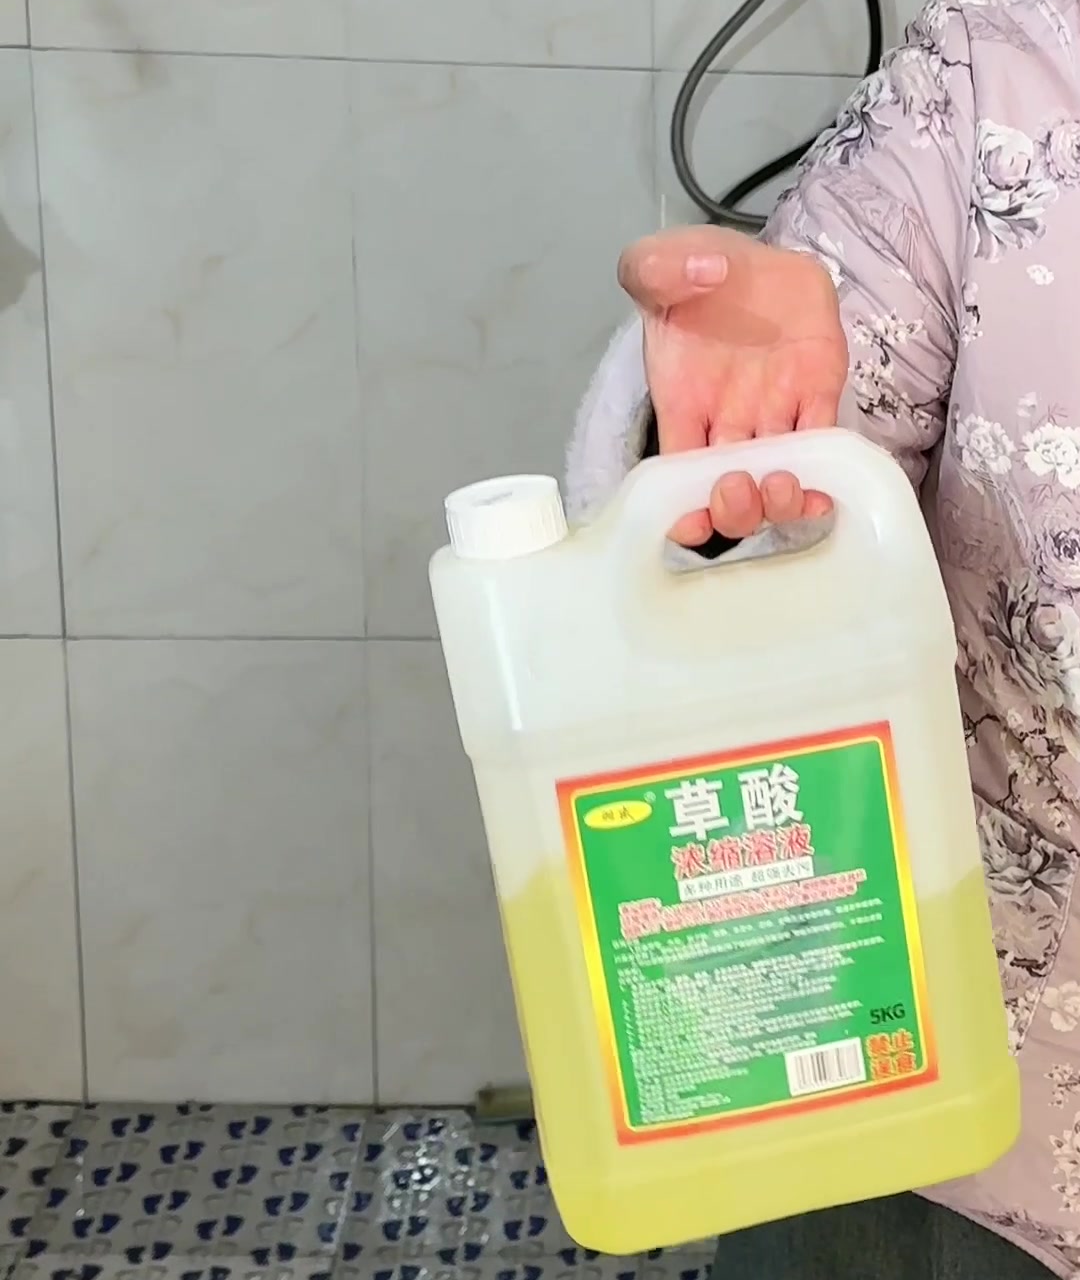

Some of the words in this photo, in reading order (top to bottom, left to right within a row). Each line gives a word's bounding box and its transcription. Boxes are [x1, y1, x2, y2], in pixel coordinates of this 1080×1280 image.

[664, 763, 804, 841] 草酸
[670, 823, 815, 880] 浓缩溶液
[869, 1003, 905, 1025] 5KG
